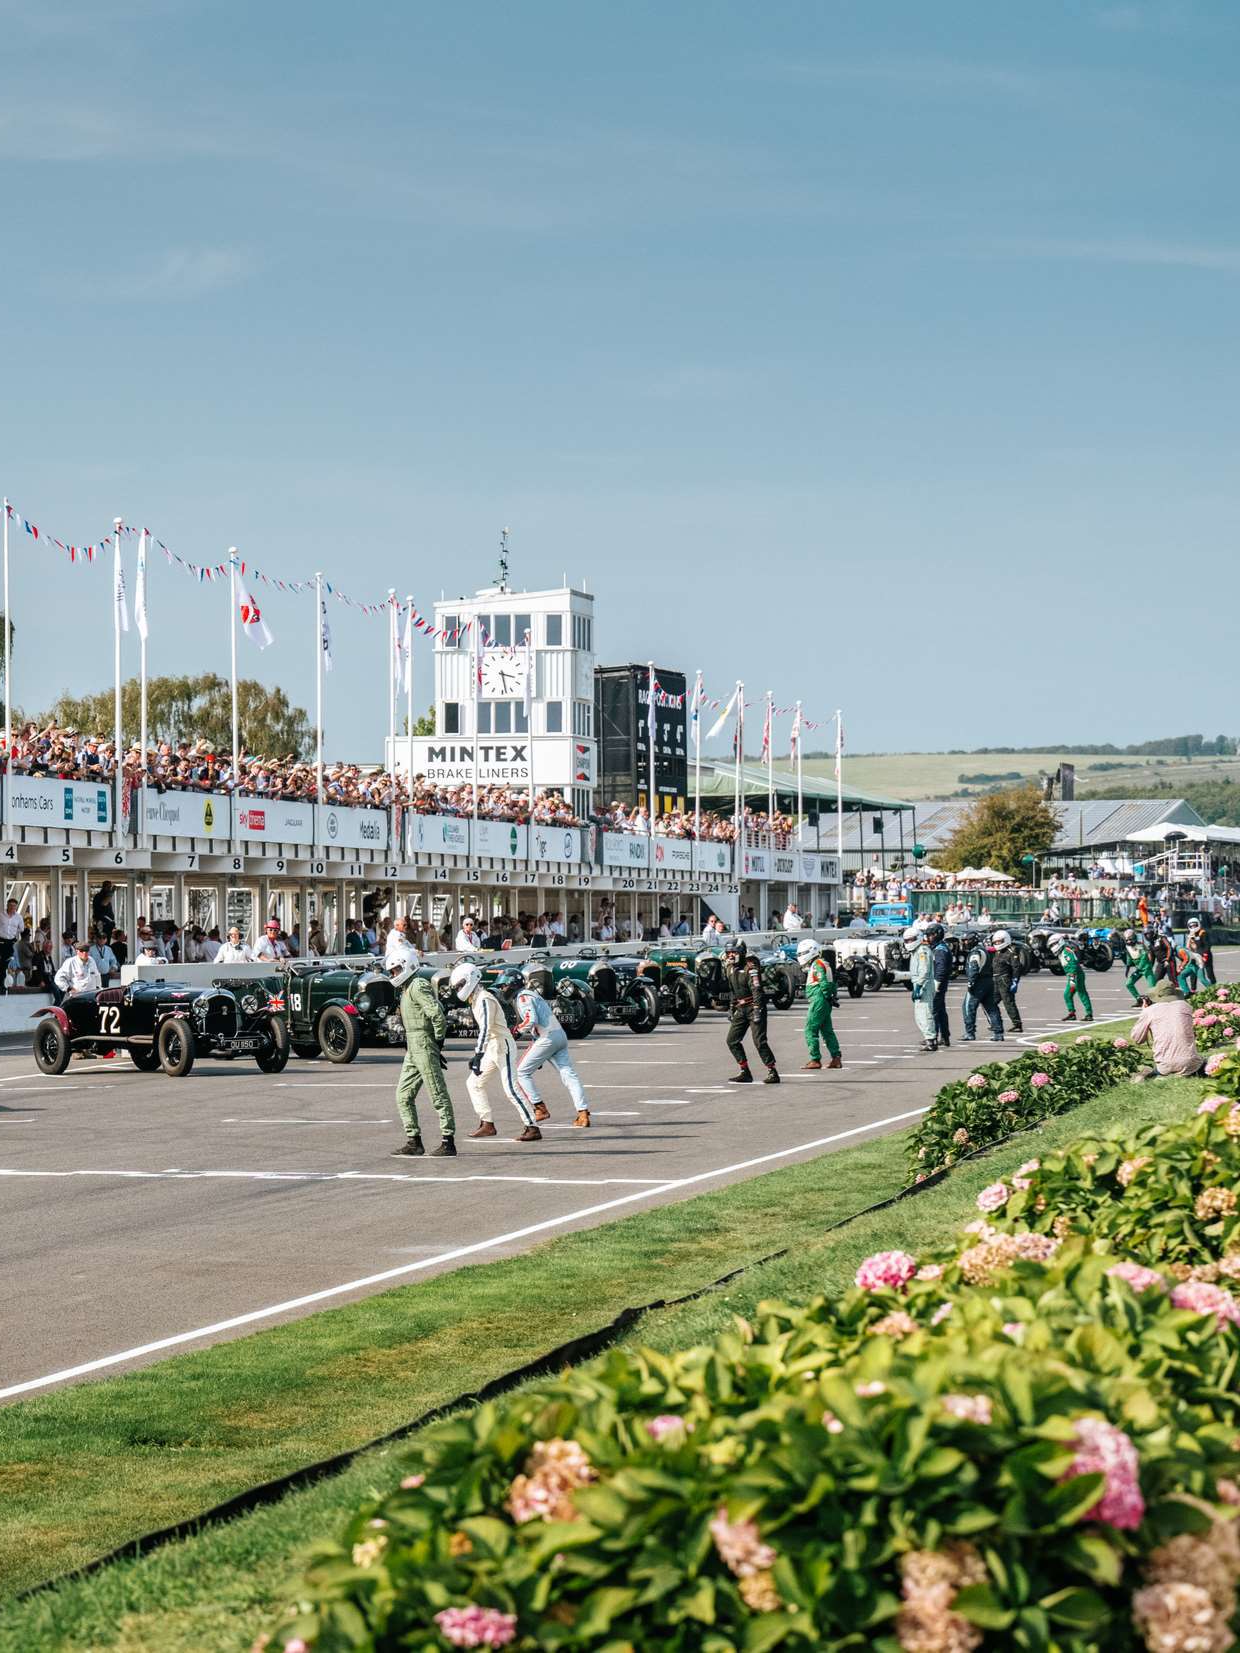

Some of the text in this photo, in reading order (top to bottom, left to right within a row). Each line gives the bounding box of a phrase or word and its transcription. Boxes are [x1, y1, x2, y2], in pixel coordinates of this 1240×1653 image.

[428, 746, 527, 762] MINTEX
[427, 767, 529, 779] BRAKE LINERS
[11, 793, 37, 810] onhams
[39, 795, 54, 810] Cars
[6, 846, 14, 859] 4
[63, 849, 69, 861] 5
[115, 852, 122, 864] 6
[188, 856, 195, 867] 7
[233, 858, 240, 869] 8
[277, 861, 284, 871] 9
[311, 863, 323, 873] 10
[351, 864, 361, 875] 11
[385, 867, 397, 876] 12
[435, 870, 446, 879] 14
[468, 872, 478, 880] 15
[497, 873, 507, 882] 16
[525, 874, 535, 883] 17
[553, 875, 563, 884] 18
[579, 877, 589, 885] 19
[623, 880, 634, 888] 20
[647, 881, 656, 889] 21
[667, 882, 678, 891] 22
[689, 883, 699, 891] 23
[708, 884, 718, 893] 24
[728, 886, 739, 895] 25
[290, 993, 301, 1011] 18
[98, 1006, 121, 1033] 72
